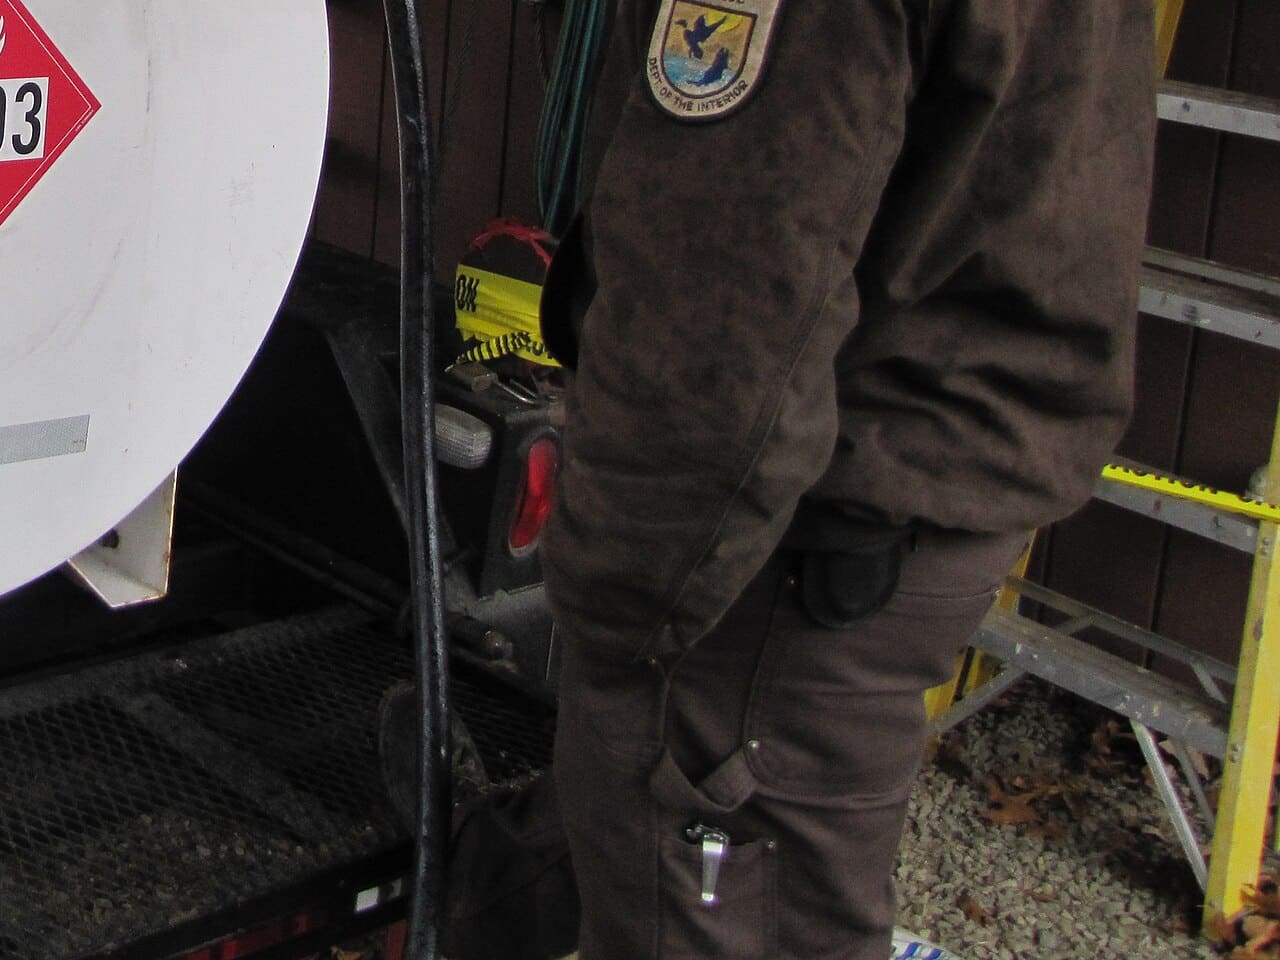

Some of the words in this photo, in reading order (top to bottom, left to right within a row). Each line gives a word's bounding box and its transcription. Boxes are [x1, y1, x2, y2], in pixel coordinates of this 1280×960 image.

[660, 87, 673, 99] OF
[673, 96, 694, 111] THE
[697, 80, 748, 112] INTERIOR
